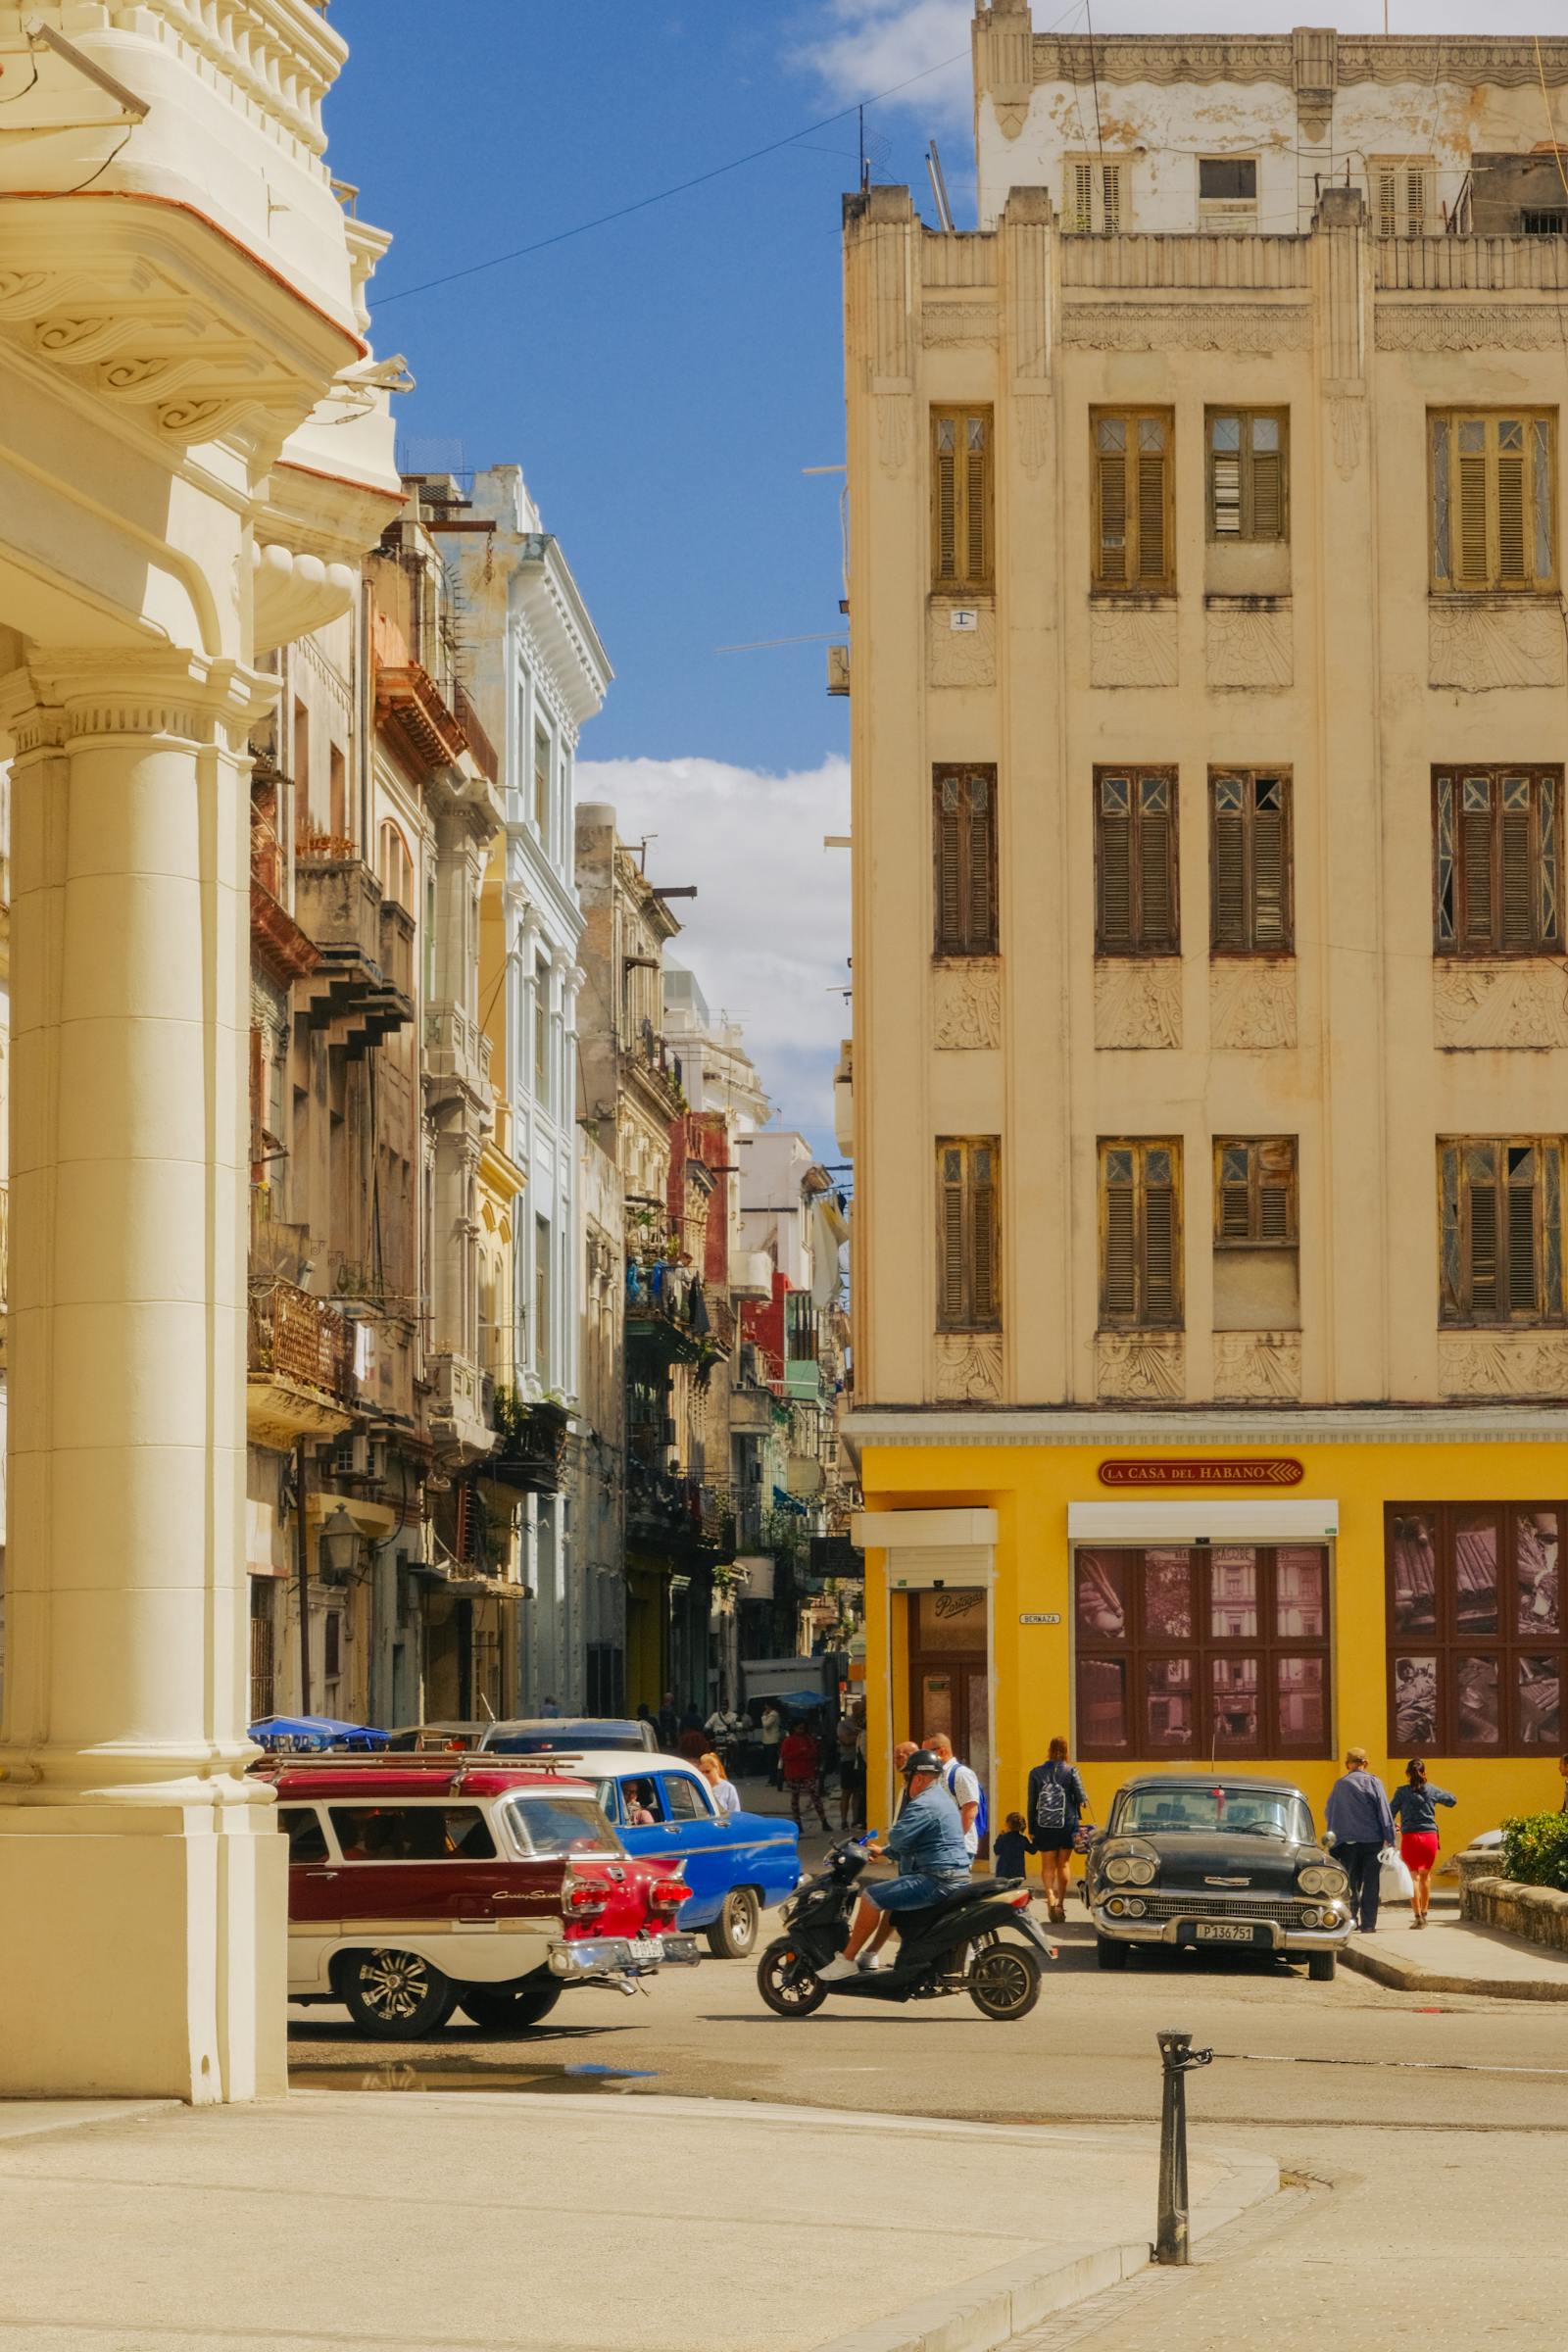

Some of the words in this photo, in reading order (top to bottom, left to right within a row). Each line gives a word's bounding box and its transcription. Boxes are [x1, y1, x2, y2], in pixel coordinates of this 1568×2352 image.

[1106, 1469, 1123, 1479] LA
[1128, 1467, 1166, 1479] CASA
[1171, 1469, 1195, 1479] DEL
[1200, 1466, 1265, 1479] HABANO
[1203, 1925, 1251, 1939] P136751
